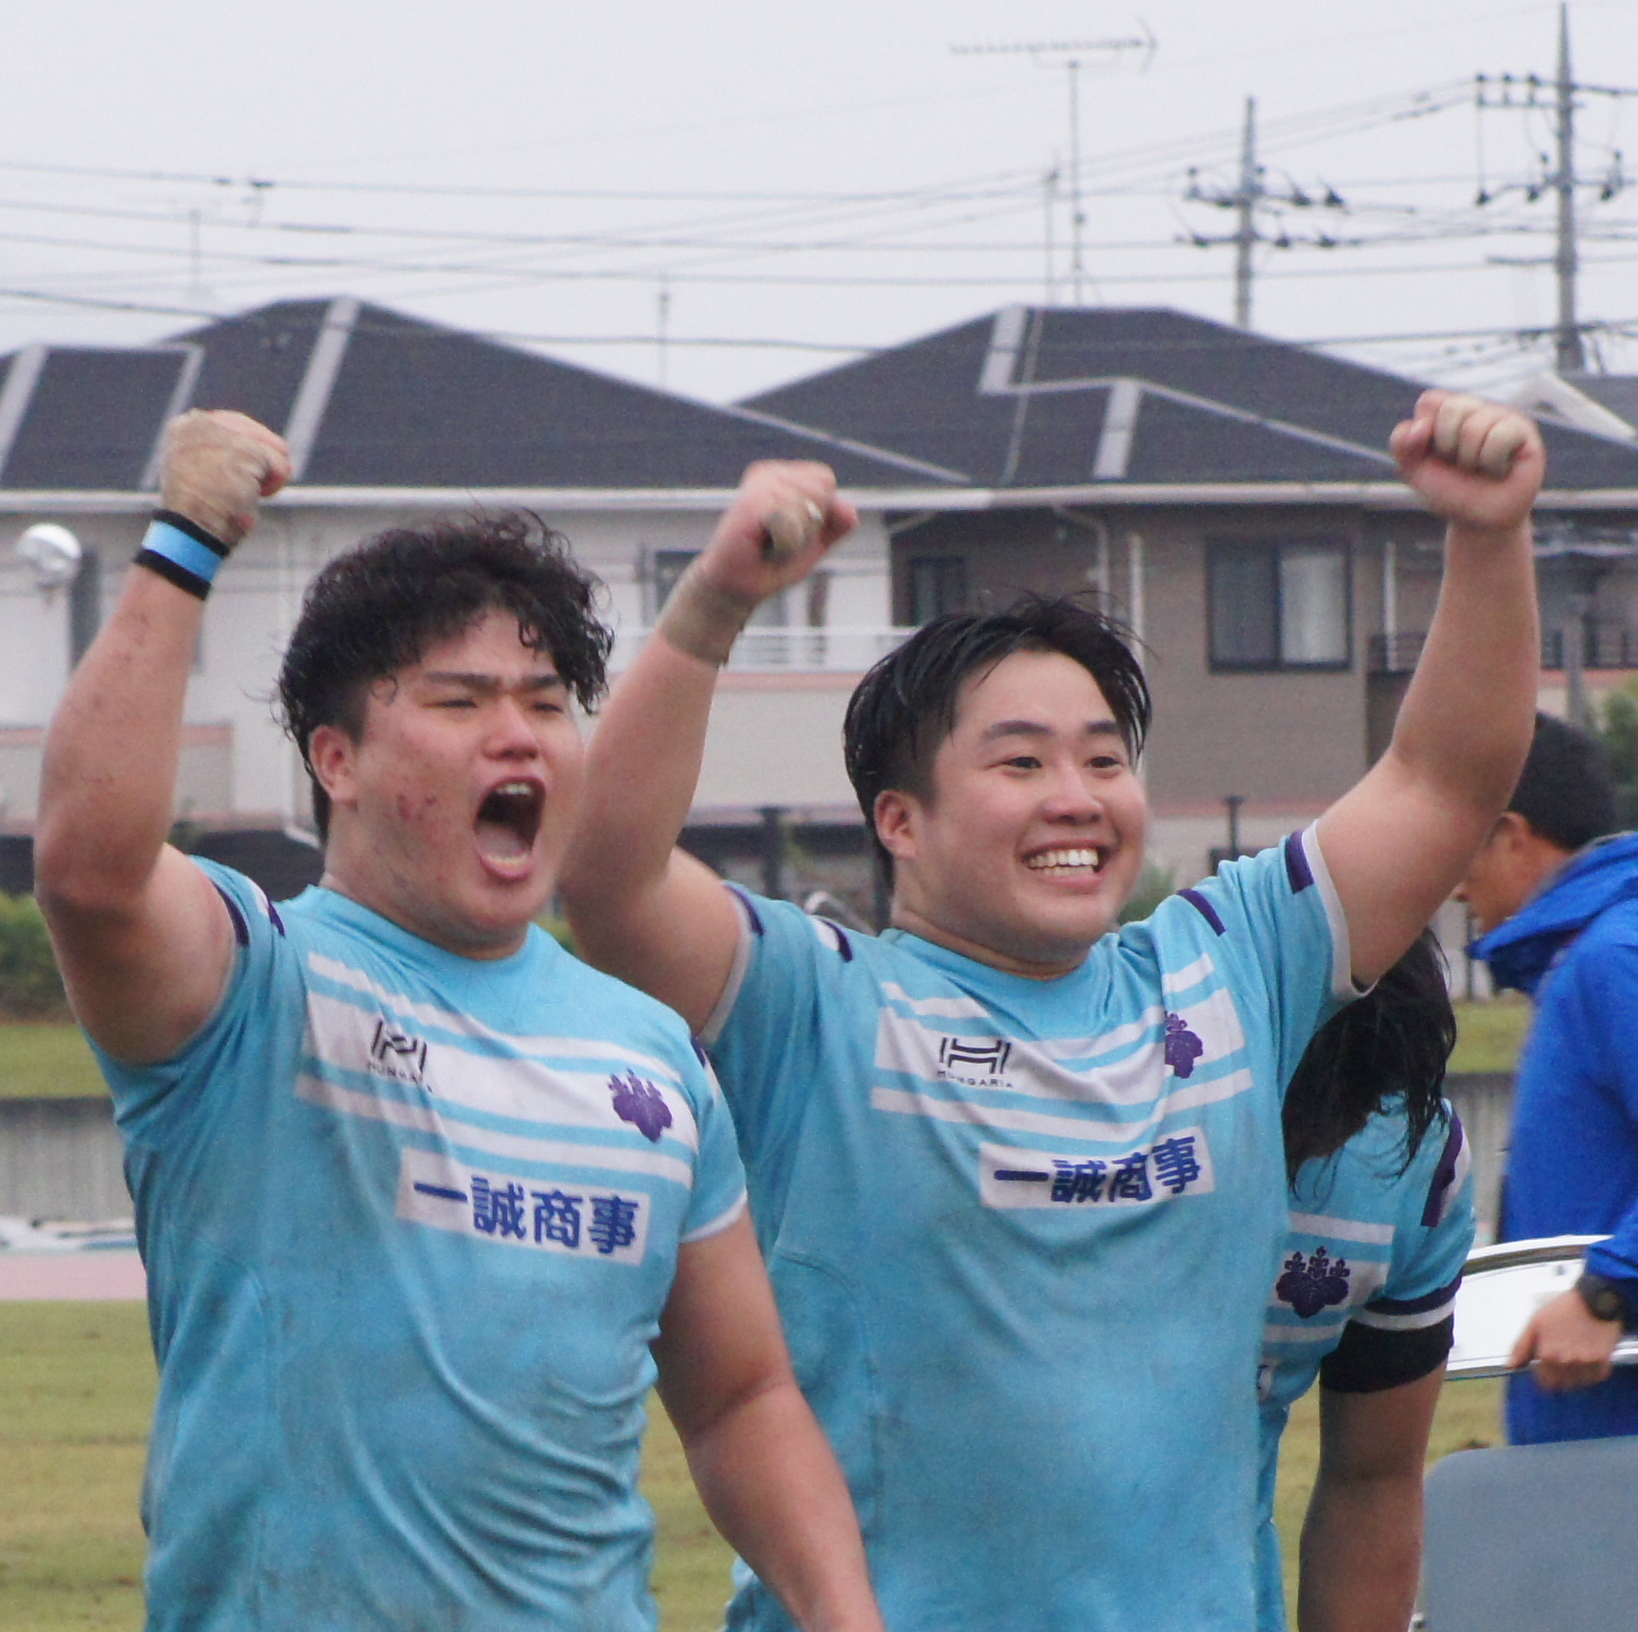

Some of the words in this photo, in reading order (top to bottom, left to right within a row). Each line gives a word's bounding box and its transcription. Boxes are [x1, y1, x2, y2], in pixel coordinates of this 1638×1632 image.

[993, 1136, 1204, 1206] 一誠商事
[412, 1174, 639, 1257] 一誠商事
